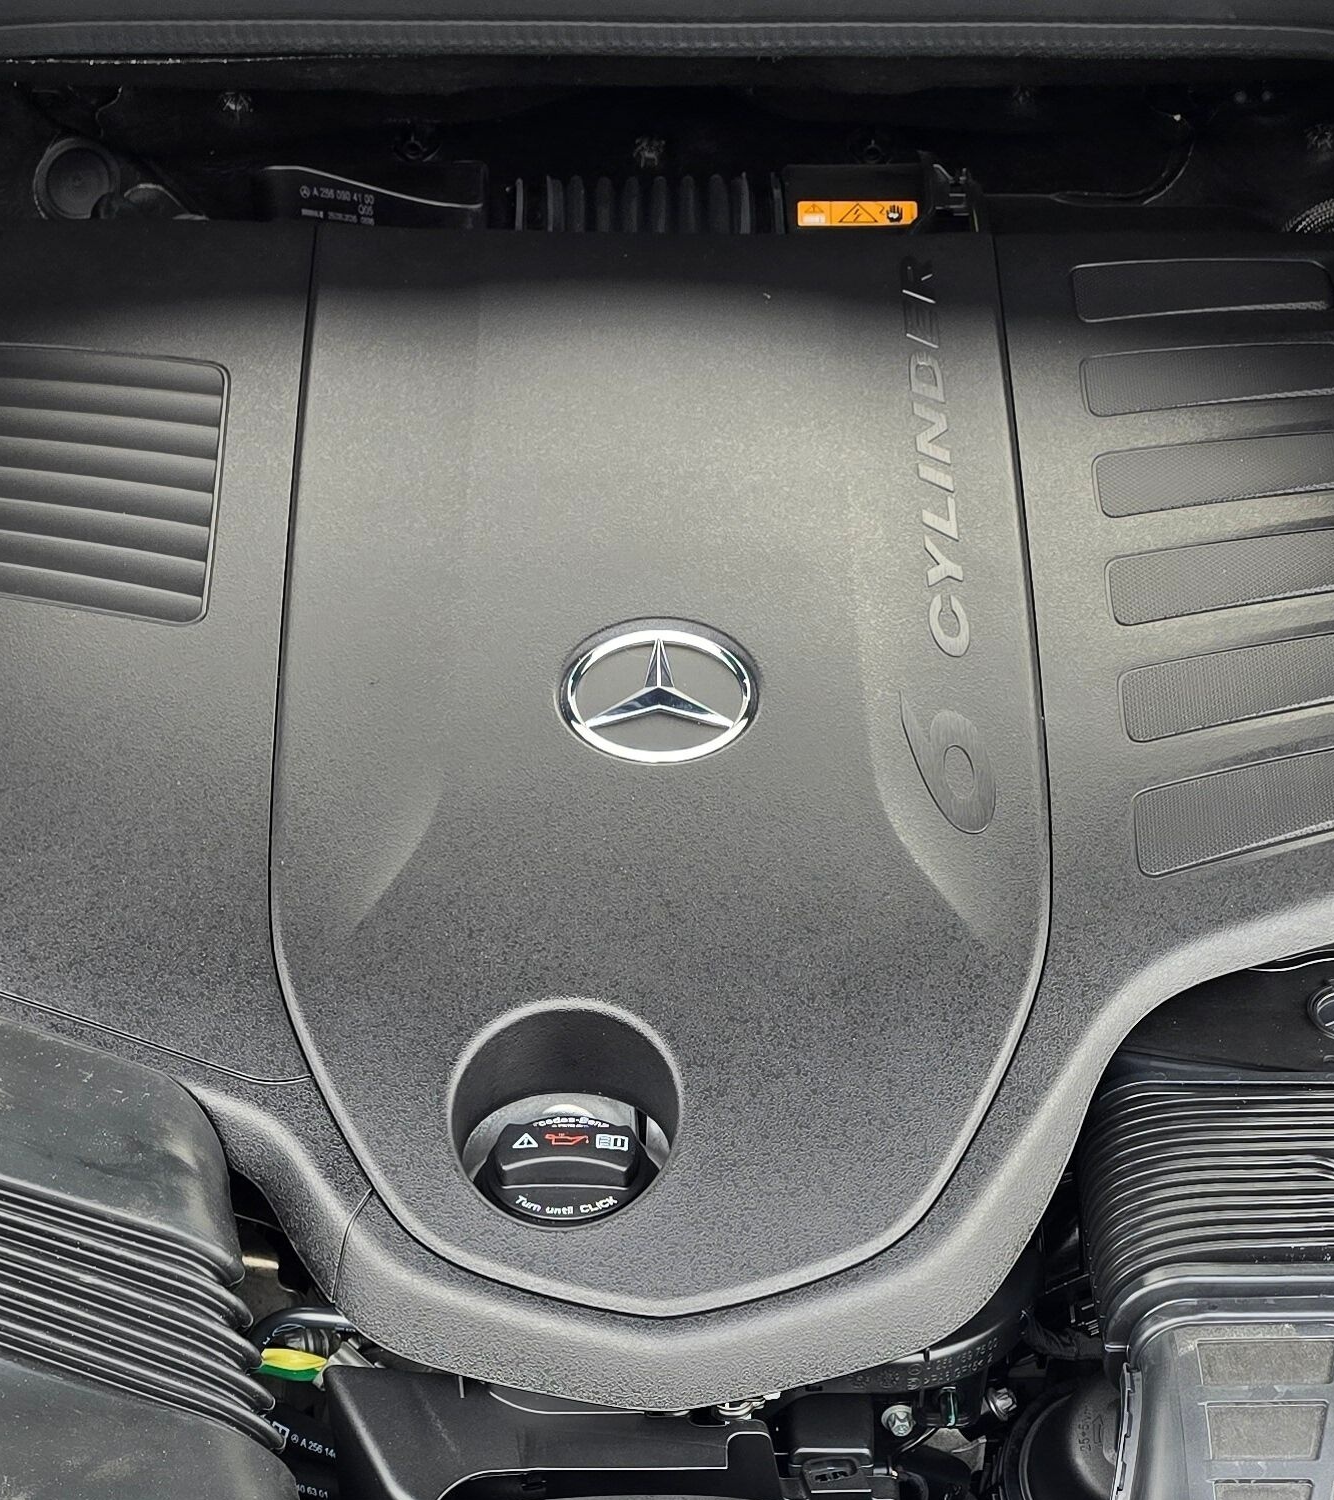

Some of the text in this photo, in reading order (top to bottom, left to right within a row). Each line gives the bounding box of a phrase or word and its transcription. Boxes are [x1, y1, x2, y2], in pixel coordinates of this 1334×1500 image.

[899, 254, 996, 835] 6 CYLINDER
[515, 1195, 618, 1216] Turn until CLICK
[300, 1438, 336, 1459] A 256 14
[307, 1486, 317, 1497] 63
[318, 1489, 328, 1499] 01
